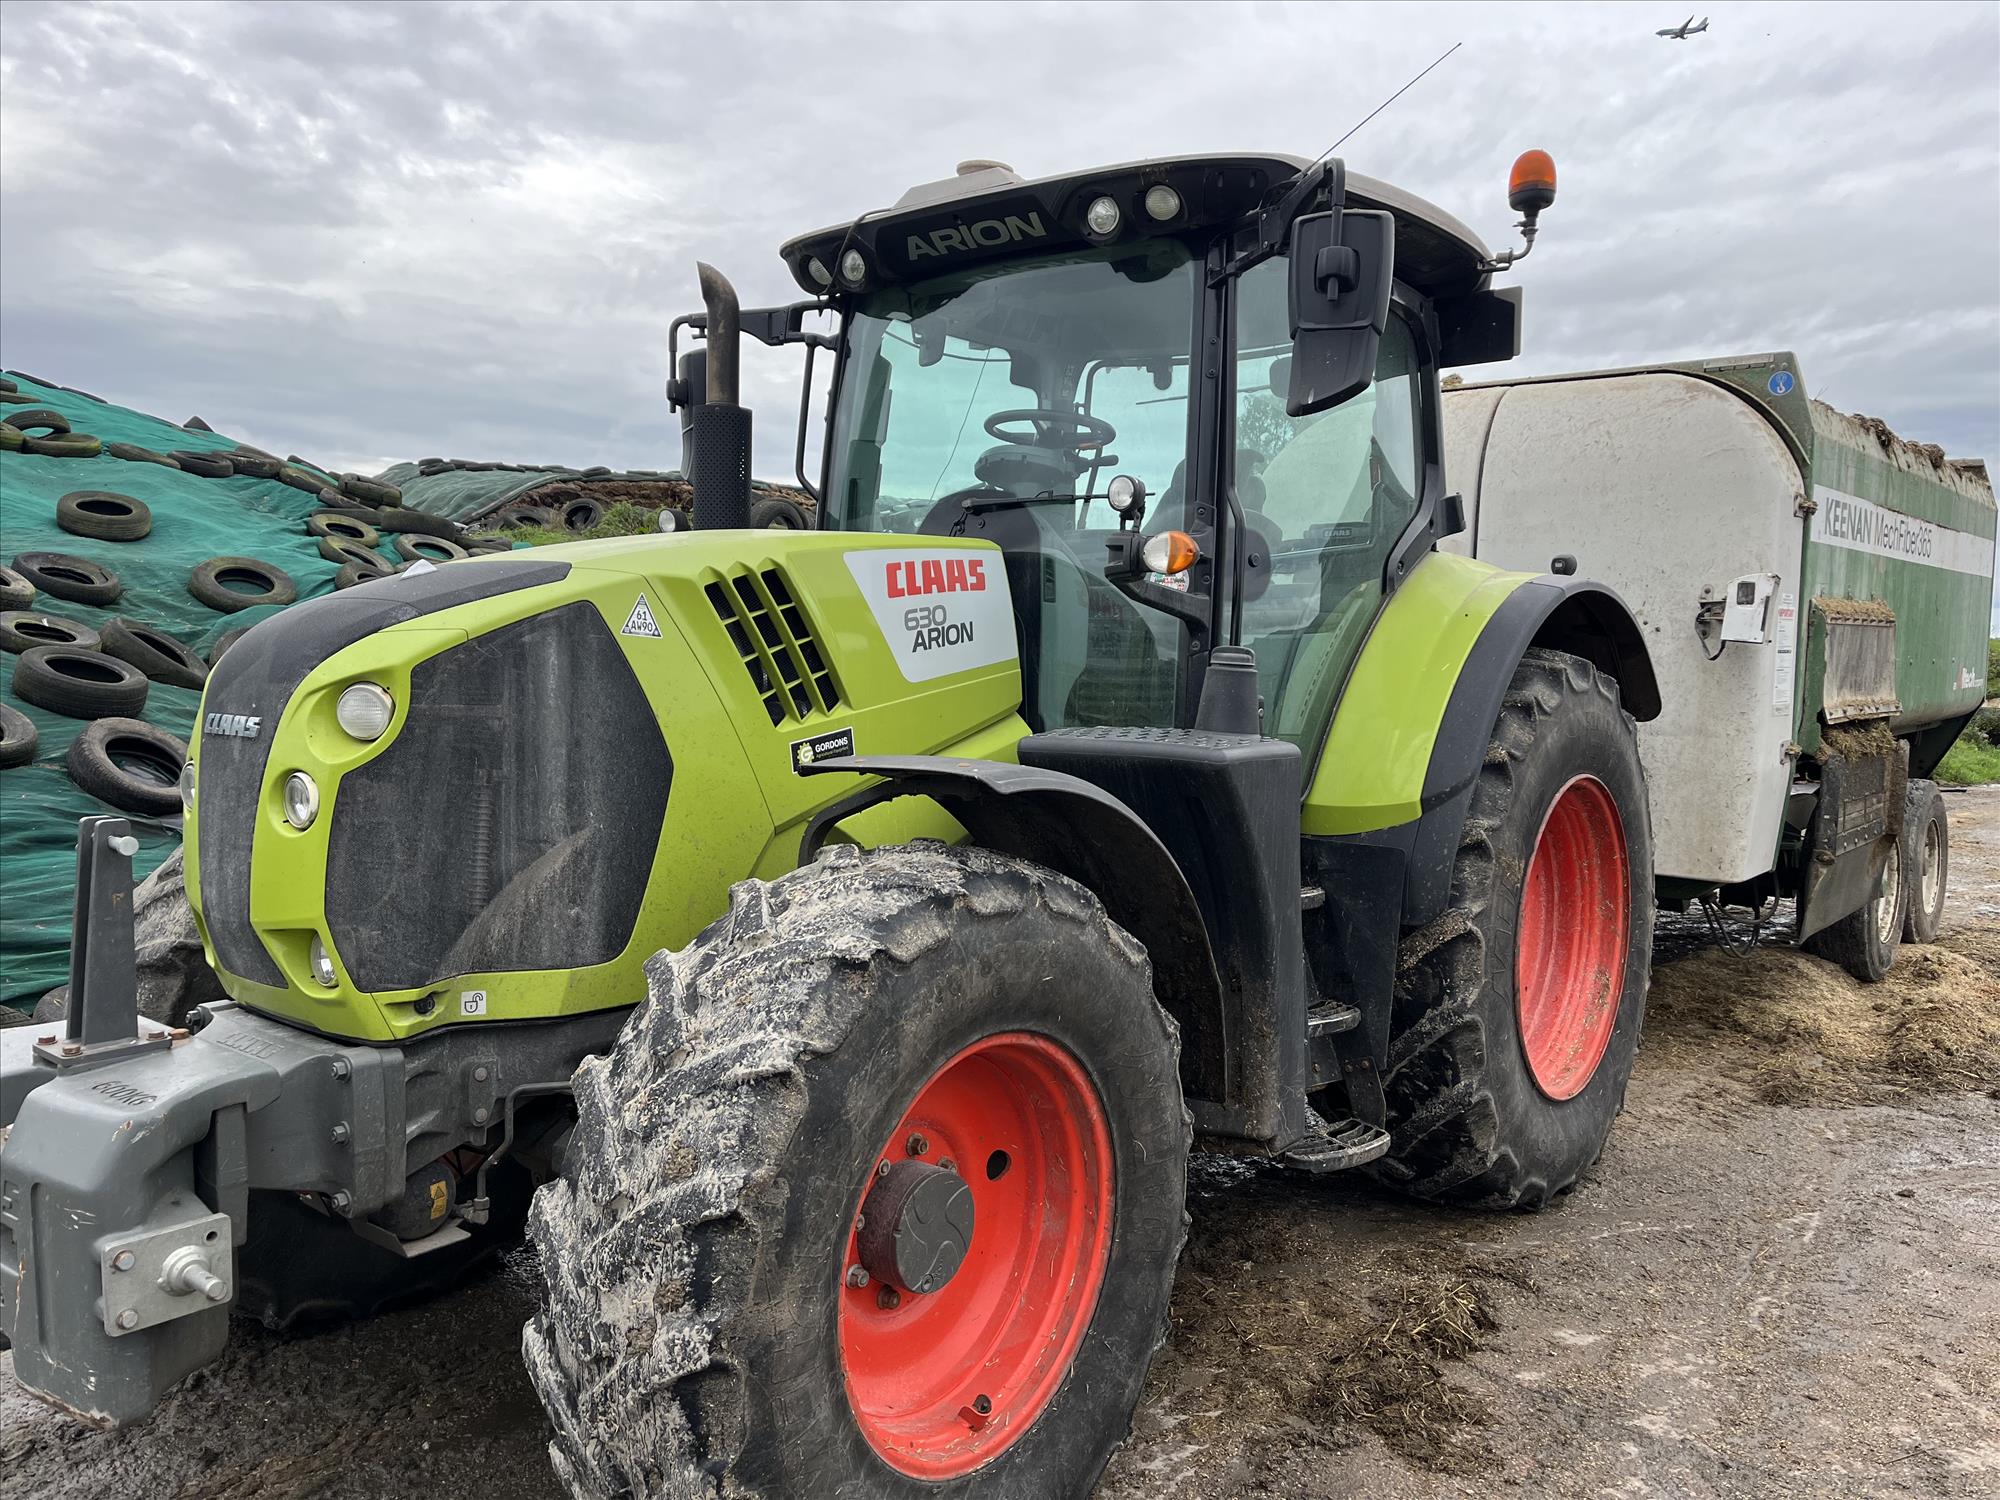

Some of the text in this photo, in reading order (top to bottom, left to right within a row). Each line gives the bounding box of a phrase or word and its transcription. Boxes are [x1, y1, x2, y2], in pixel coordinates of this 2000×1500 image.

[907, 211, 1047, 261] ARION
[1824, 497, 1873, 545] KEENAN
[885, 559, 986, 599] CLAAS
[637, 610, 647, 621] 61
[904, 604, 947, 631] 630
[912, 621, 974, 653] ARION
[204, 713, 262, 738] CLAAS
[815, 736, 848, 753] GORDONS
